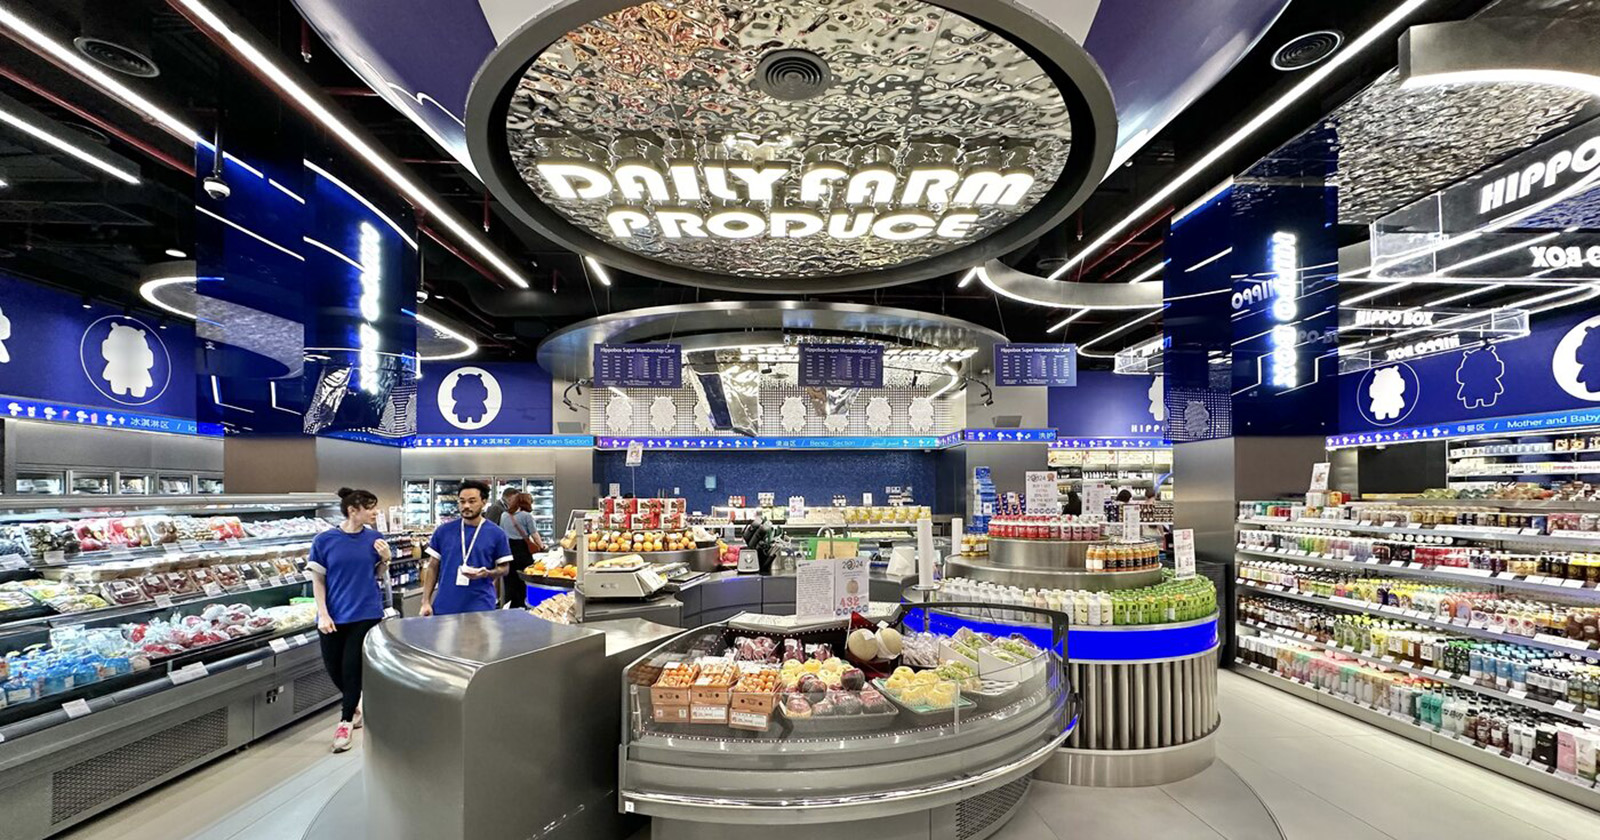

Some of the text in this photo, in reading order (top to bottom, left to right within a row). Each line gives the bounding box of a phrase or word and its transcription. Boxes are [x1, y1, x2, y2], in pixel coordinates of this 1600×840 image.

[536, 163, 1036, 206] DAILY FARM
[1478, 136, 1600, 215] HIPPO
[606, 209, 980, 240] PRODUCE
[1355, 310, 1434, 326] HIPPO BOX
[188, 424, 196, 432] Ic
[1507, 420, 1542, 428] Mother
[1546, 416, 1567, 425] and
[1570, 414, 1600, 424] Baby
